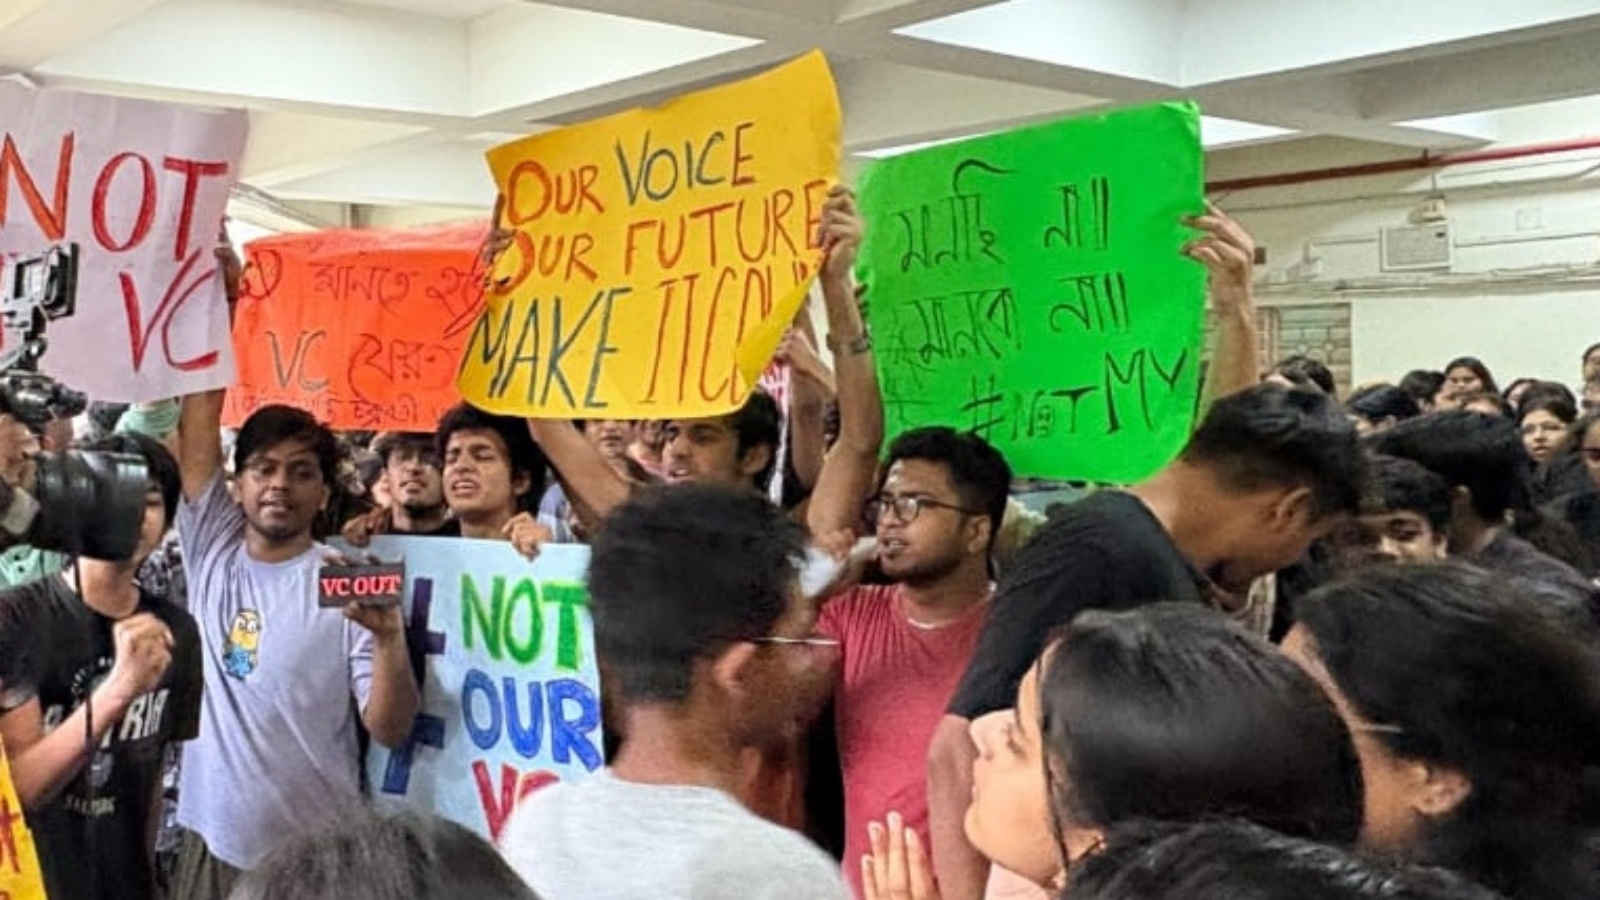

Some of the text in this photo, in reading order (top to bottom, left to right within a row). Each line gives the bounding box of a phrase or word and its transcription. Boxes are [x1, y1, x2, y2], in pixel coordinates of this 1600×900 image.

[0, 131, 229, 262] NOT
[507, 122, 756, 226] OUR VOICE
[490, 179, 829, 296] OUR FUTURE
[118, 247, 219, 373] VC
[266, 331, 330, 391] VC
[460, 286, 633, 409] MAKE
[1104, 347, 1188, 435] MY
[320, 574, 402, 598] VC OUT
[460, 572, 590, 672] NOT
[461, 667, 604, 774] OUR
